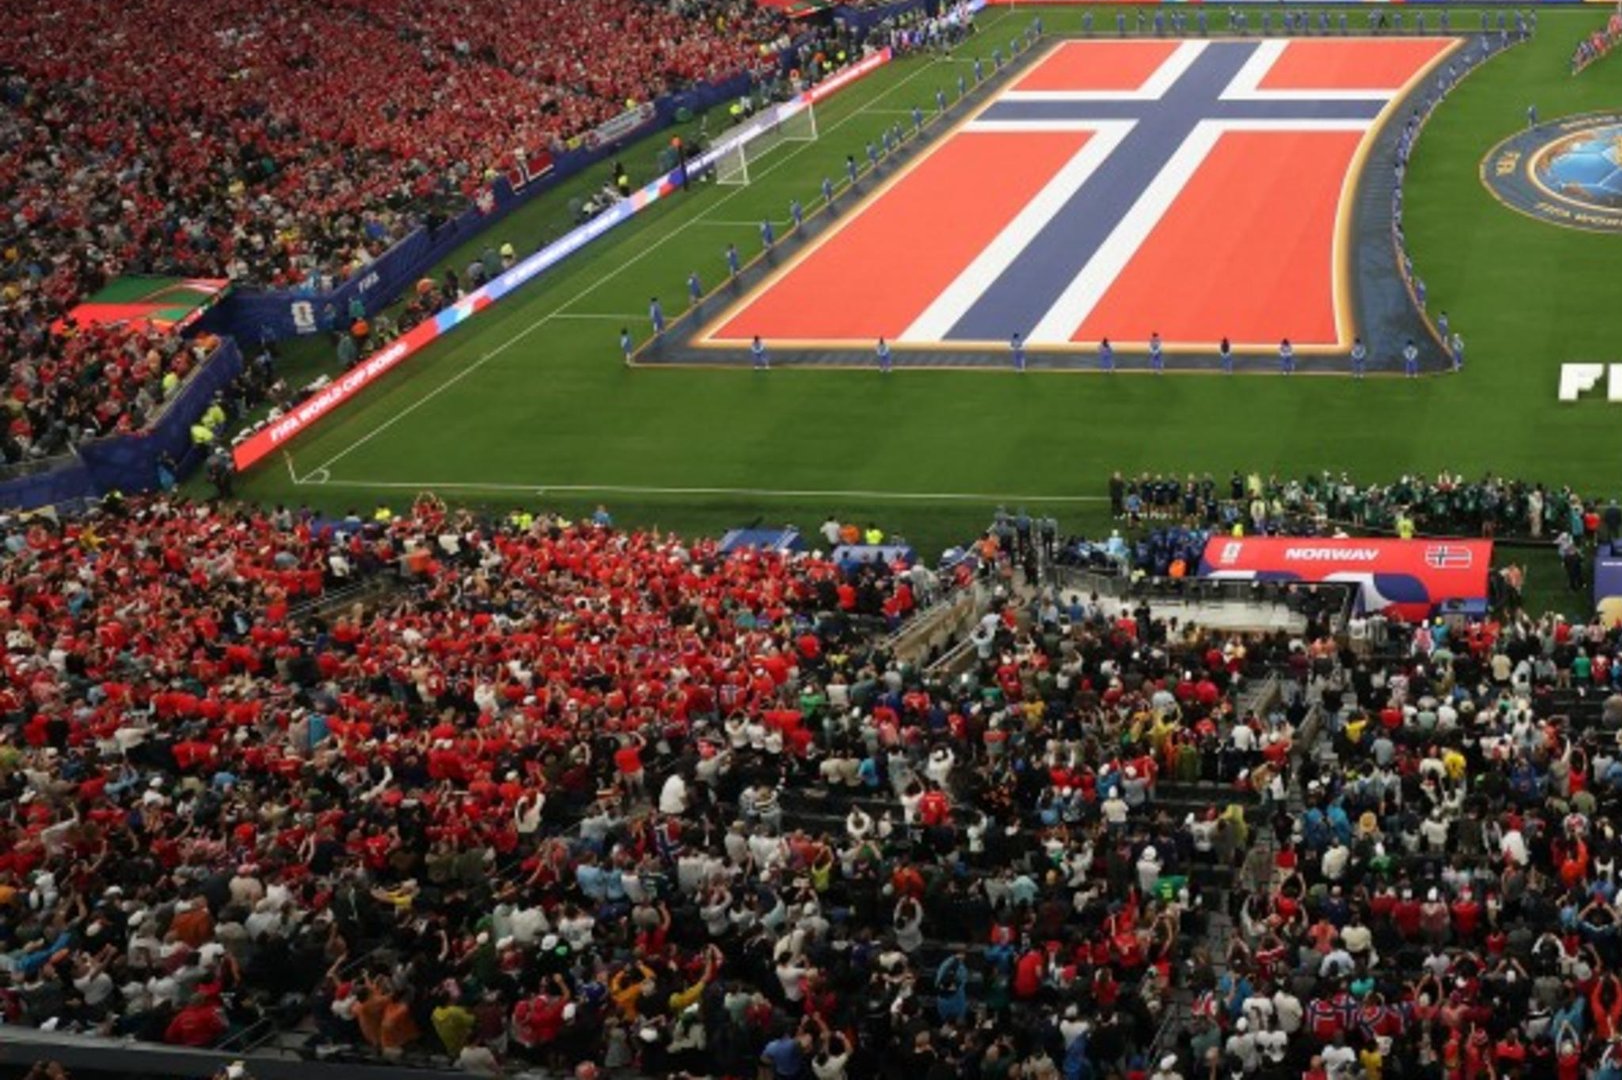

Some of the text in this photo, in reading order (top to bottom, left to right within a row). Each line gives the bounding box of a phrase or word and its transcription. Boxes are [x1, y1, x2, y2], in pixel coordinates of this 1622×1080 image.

[270, 417, 299, 441] FIFA
[299, 386, 343, 421] WORLD
[343, 369, 368, 392] CUP
[1285, 548, 1379, 560] NORWAY
